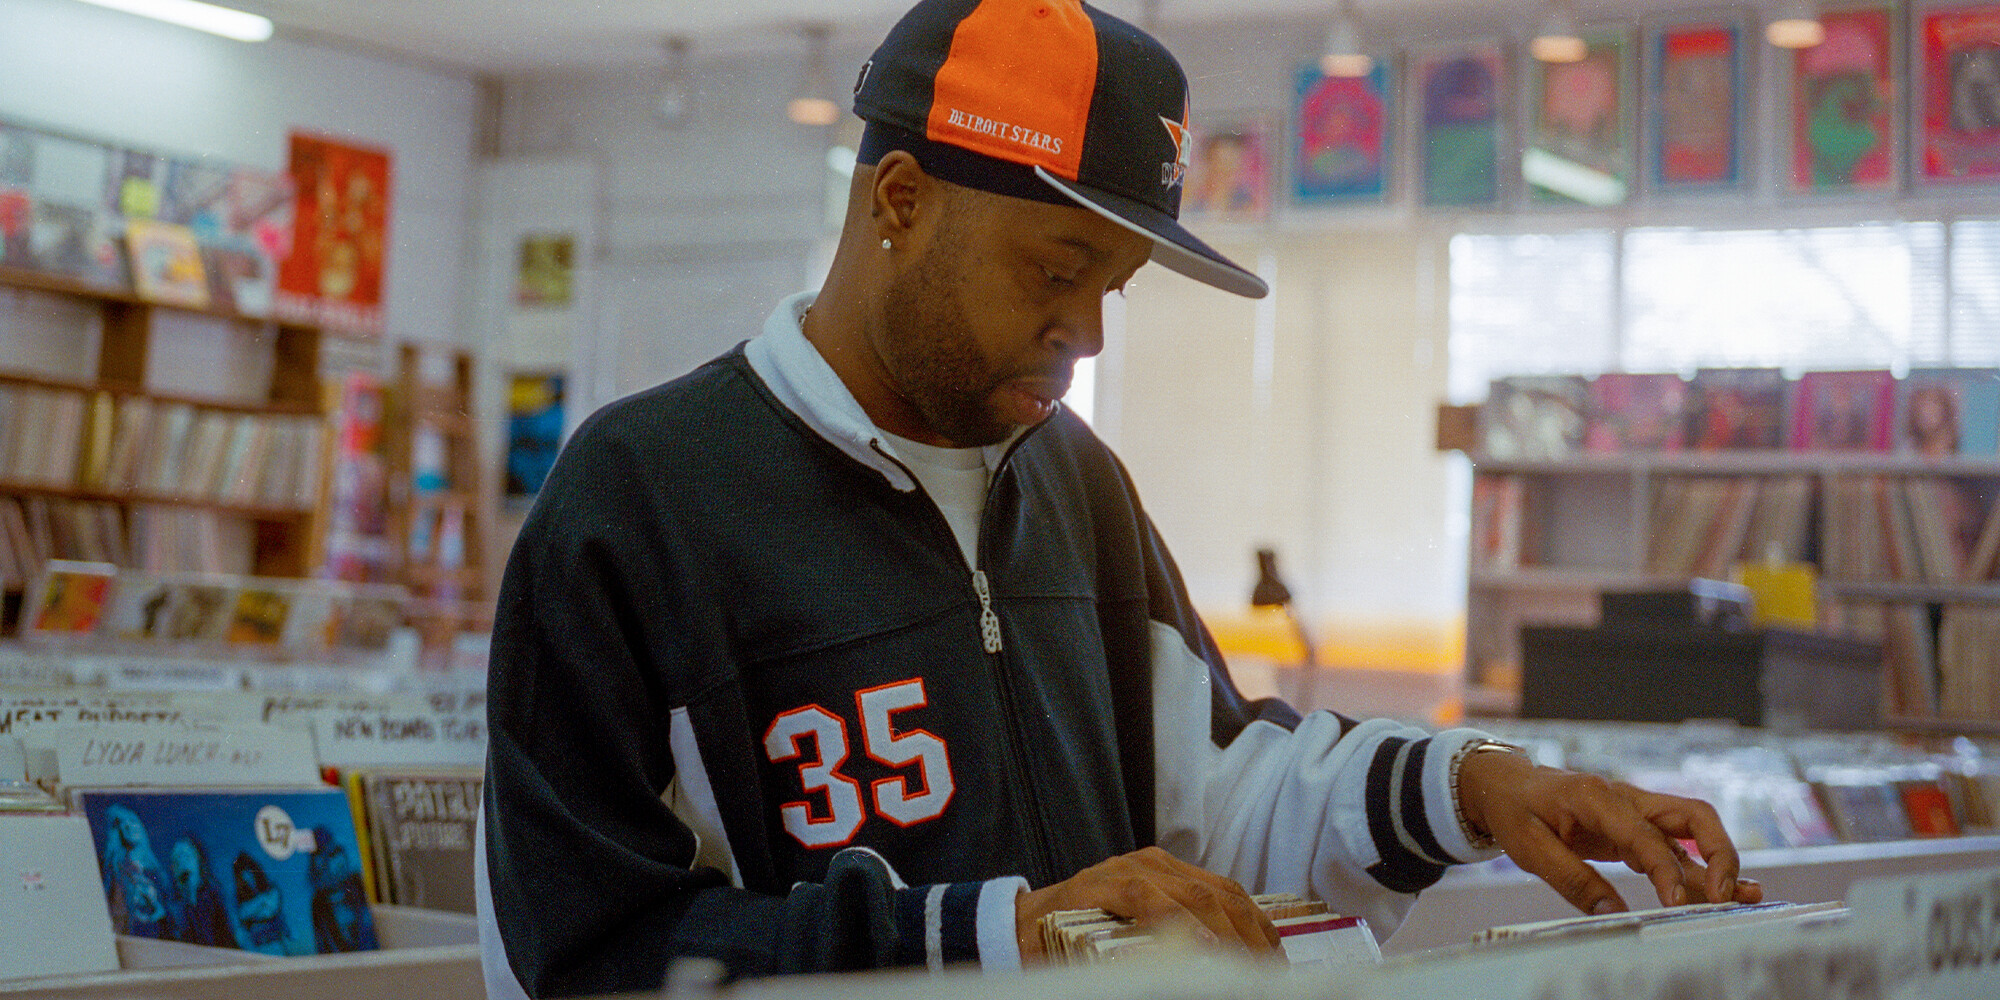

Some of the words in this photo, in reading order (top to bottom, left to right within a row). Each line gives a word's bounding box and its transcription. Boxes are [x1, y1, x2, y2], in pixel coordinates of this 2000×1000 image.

[948, 108, 1010, 139] DETROIT
[1009, 125, 1063, 155] STARS
[83, 739, 145, 766] LYDIA
[762, 676, 957, 849] 35
[262, 818, 291, 849] L7
